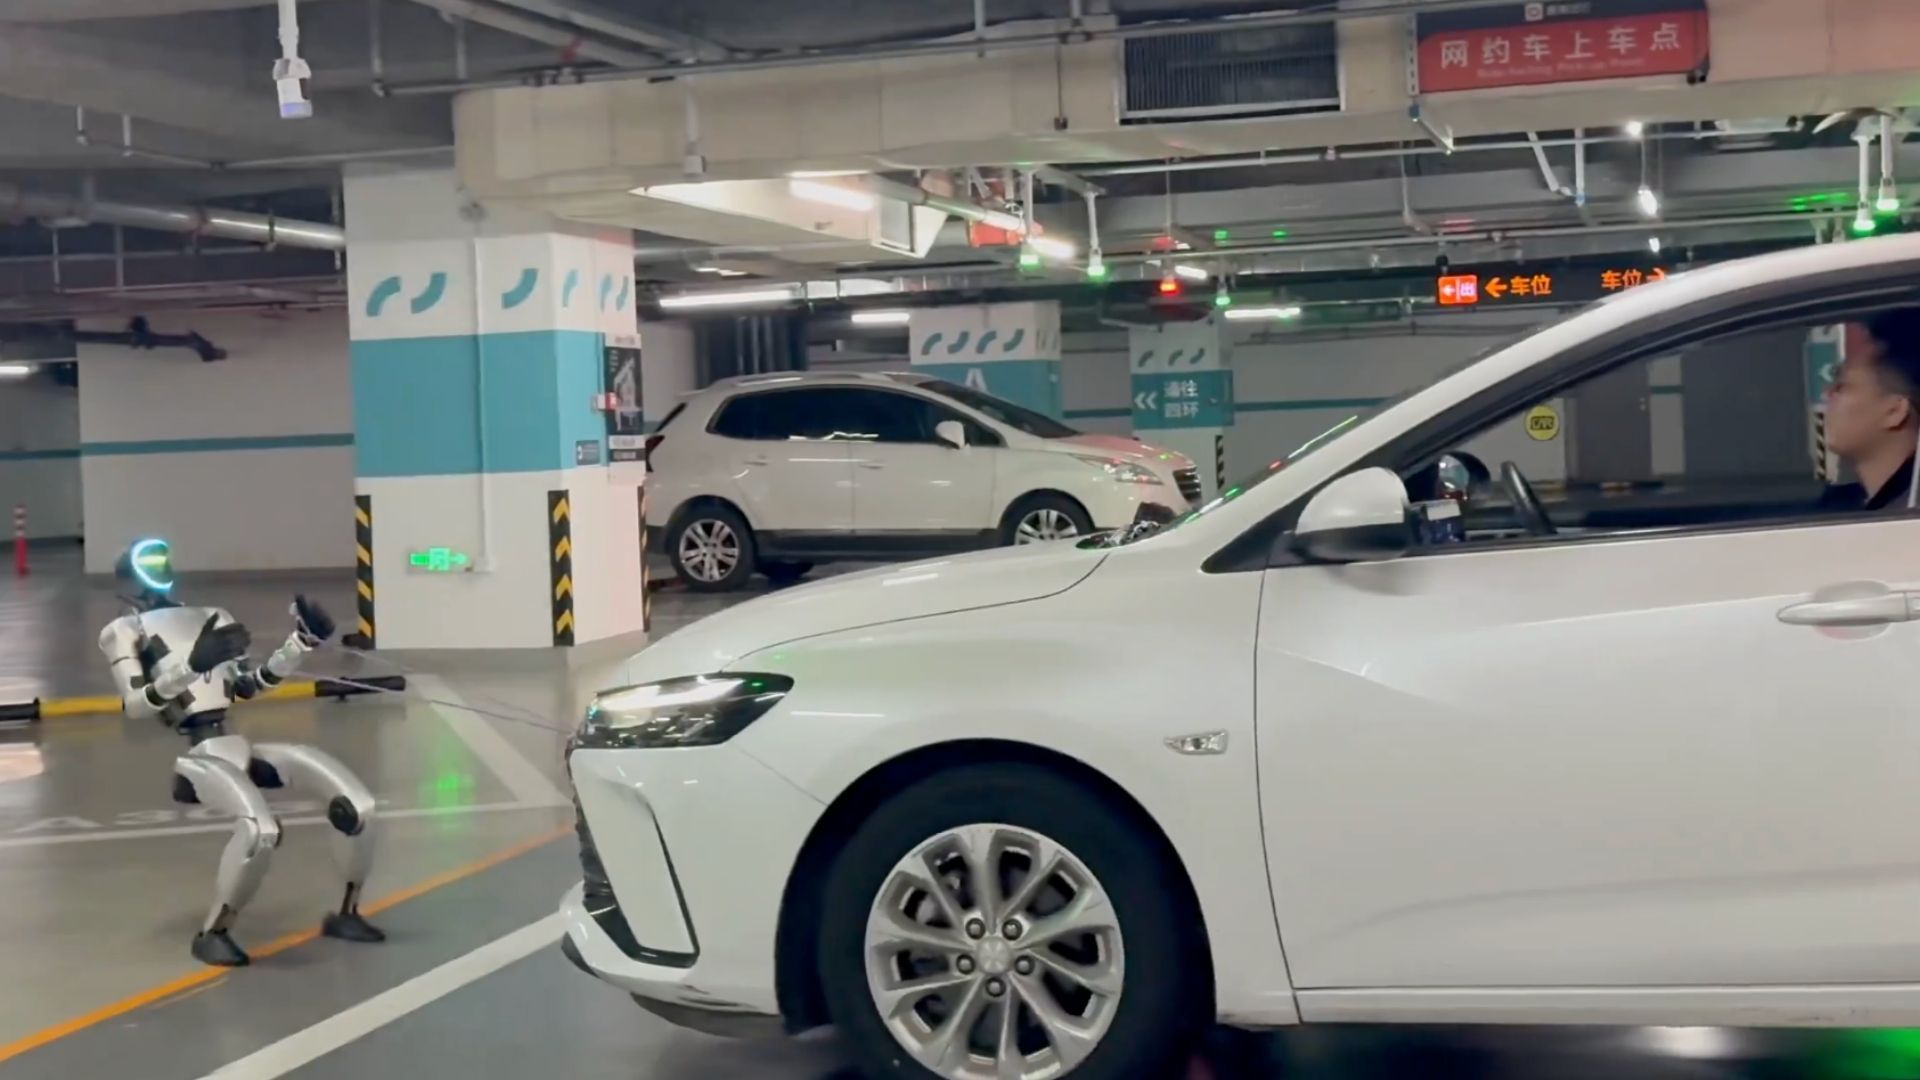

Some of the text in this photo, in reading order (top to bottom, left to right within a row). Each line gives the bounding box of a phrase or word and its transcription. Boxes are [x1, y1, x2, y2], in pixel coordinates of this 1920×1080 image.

[1440, 22, 1681, 69] 网约车上车点
[1510, 274, 1552, 296] 车位
[1601, 268, 1643, 290] 车位
[965, 367, 988, 393] A
